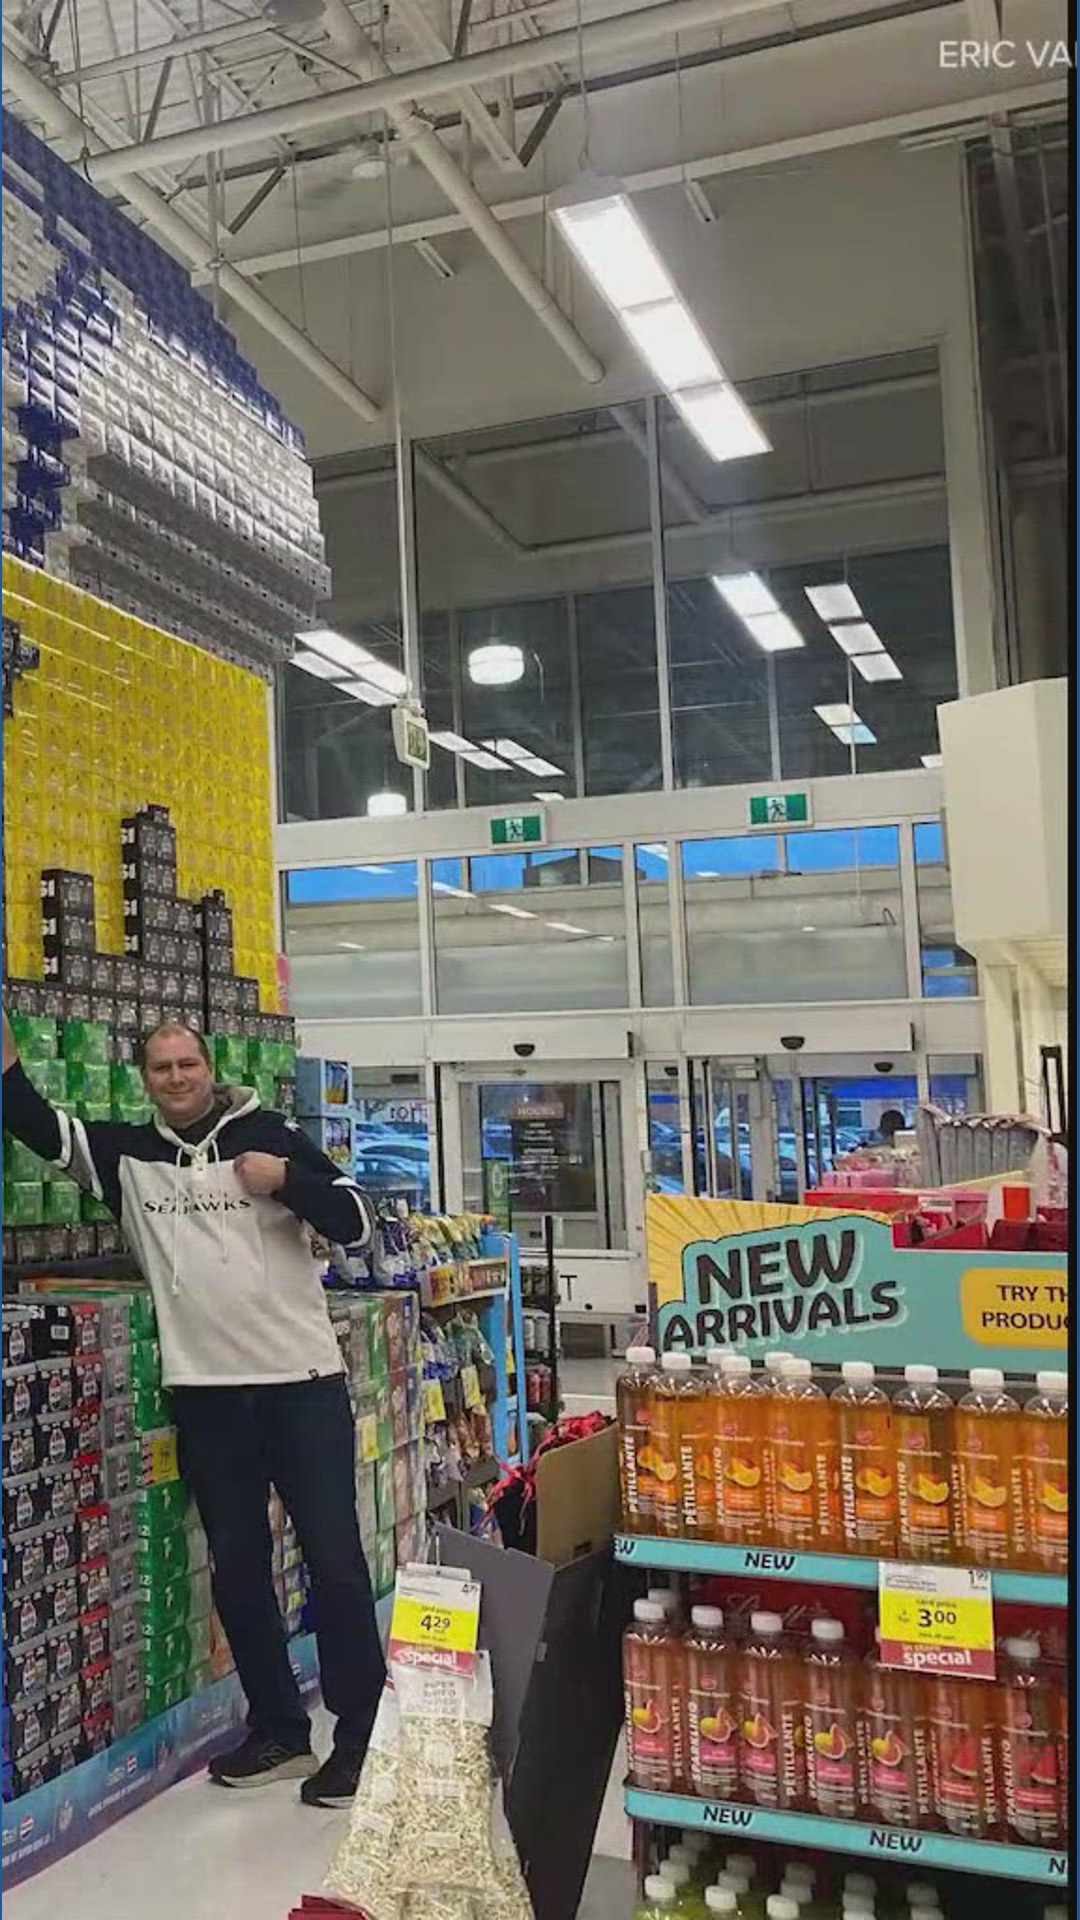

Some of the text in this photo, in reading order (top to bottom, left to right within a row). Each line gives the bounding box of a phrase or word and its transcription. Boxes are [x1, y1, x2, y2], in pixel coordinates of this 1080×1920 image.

[696, 1230, 856, 1304] NEW
[996, 1284, 1039, 1301] TRY
[663, 1280, 899, 1351] ARRIVALS
[745, 1552, 796, 1572] NEW
[902, 1650, 972, 1671] special
[703, 1806, 752, 1826] NEW
[870, 1830, 922, 1852] NEW
